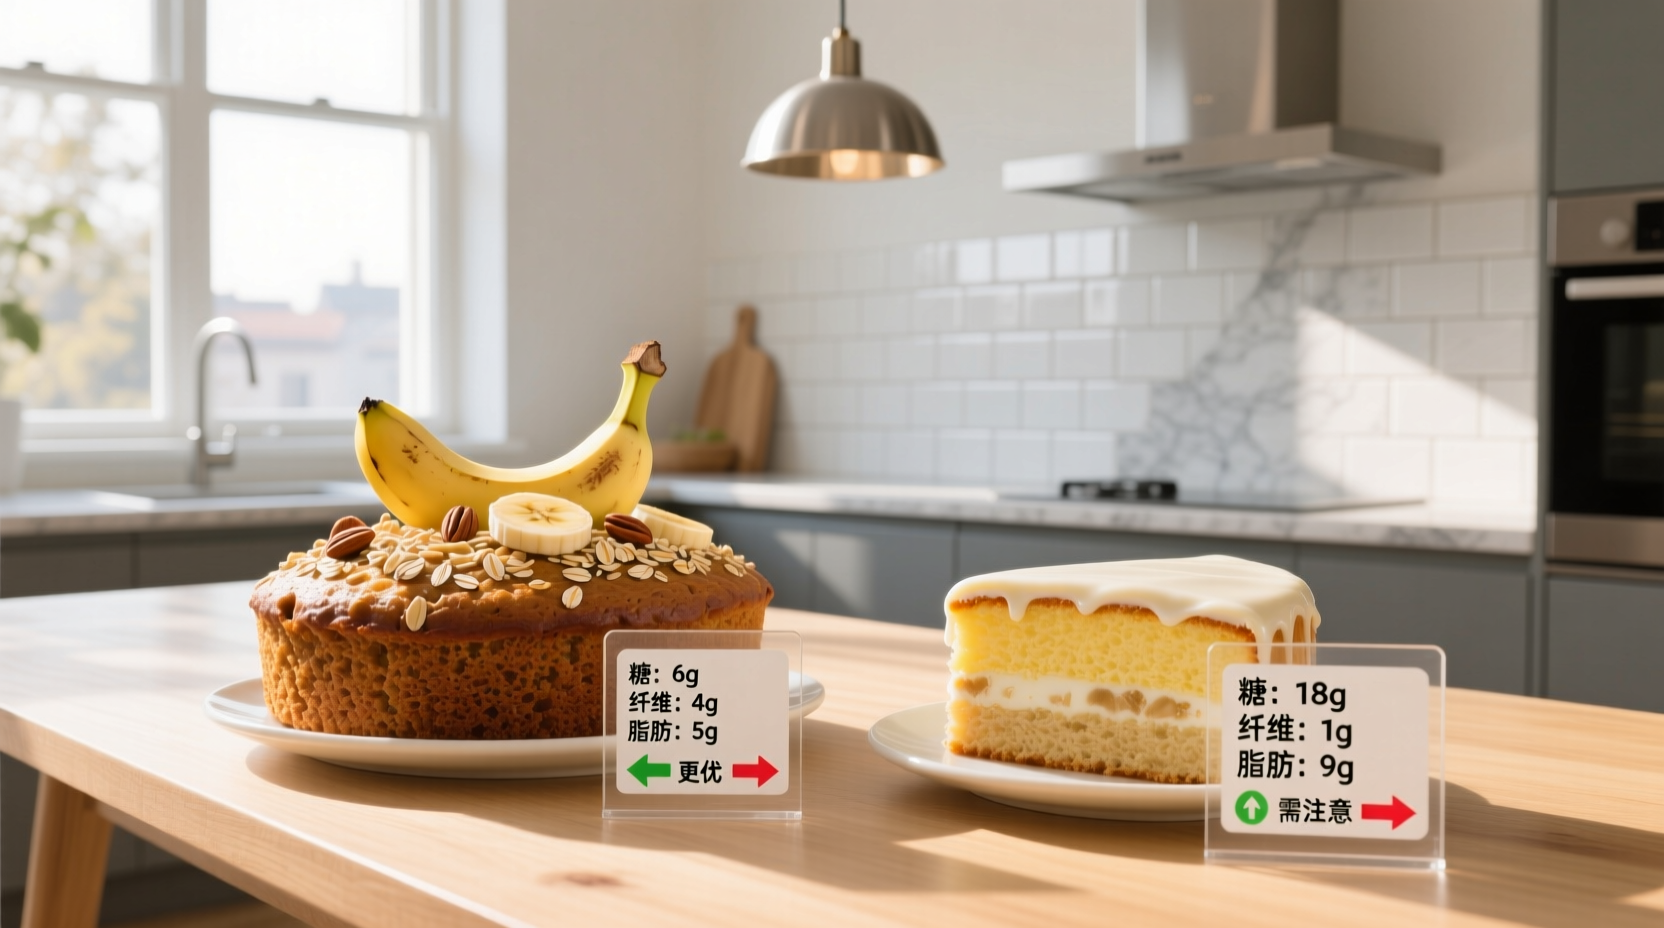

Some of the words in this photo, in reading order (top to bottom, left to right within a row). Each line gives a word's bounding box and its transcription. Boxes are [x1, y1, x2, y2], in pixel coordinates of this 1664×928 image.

[678, 760, 722, 783] 更优
[1279, 798, 1352, 824] 需注意
